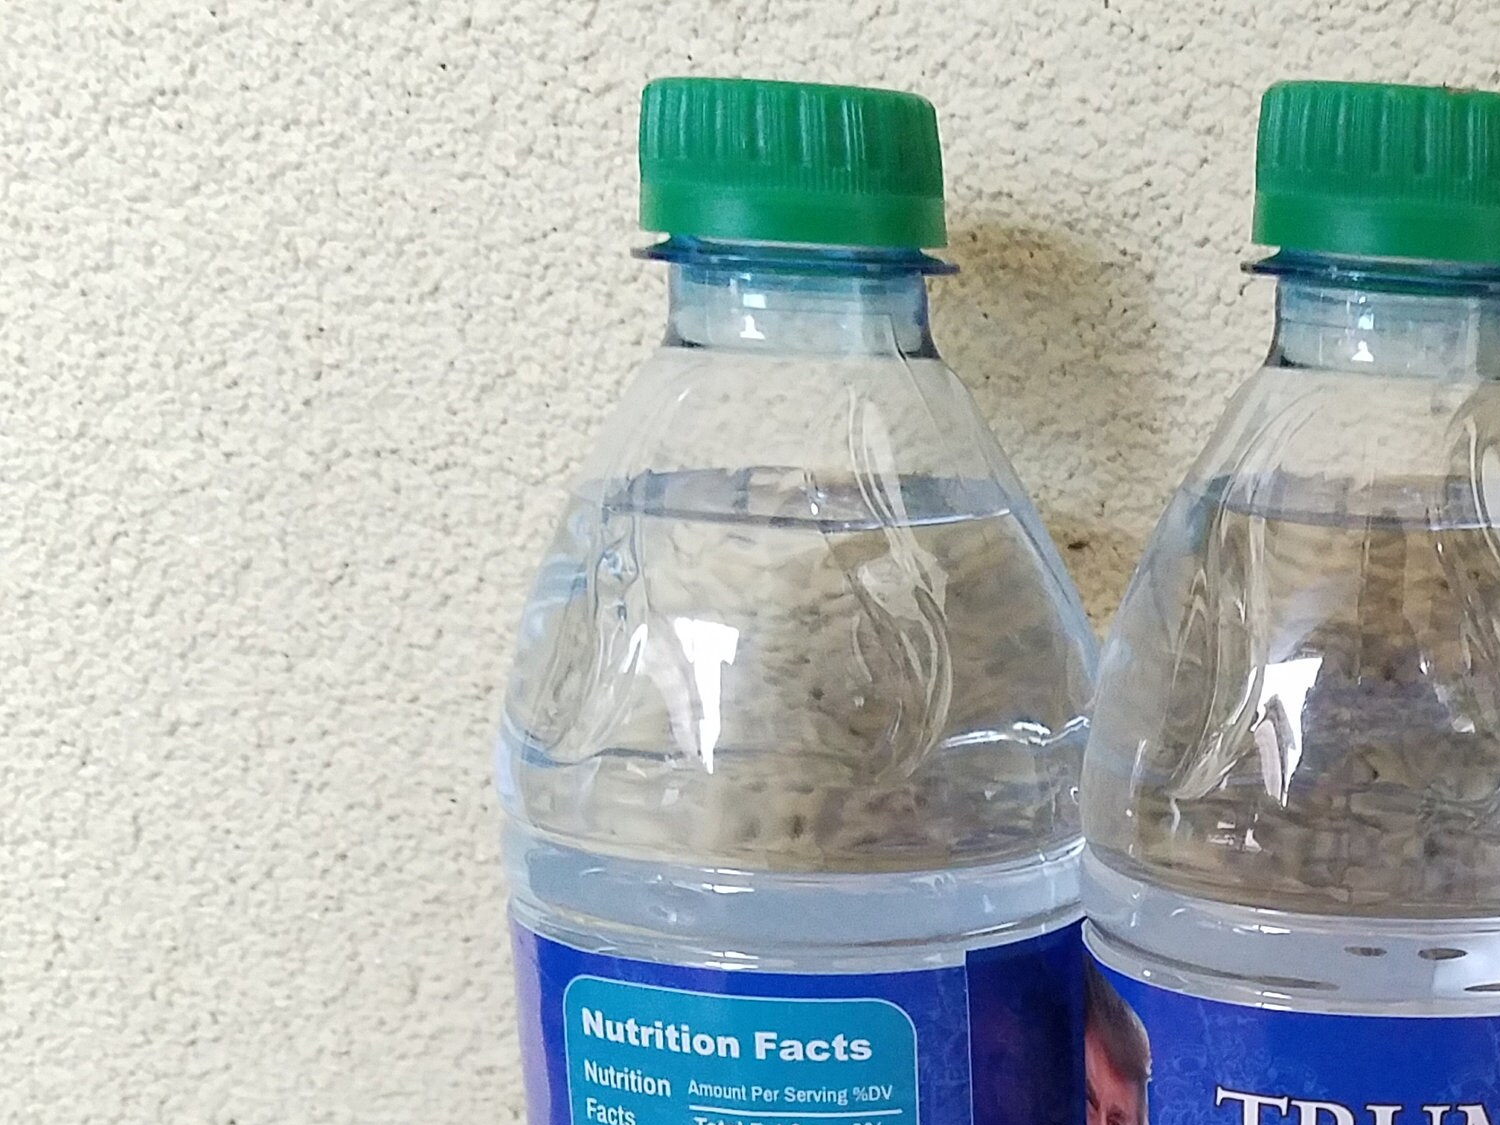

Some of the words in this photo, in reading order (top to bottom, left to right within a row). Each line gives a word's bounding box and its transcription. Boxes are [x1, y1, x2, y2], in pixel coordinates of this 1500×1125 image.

[581, 1007, 740, 1058] Nutrition
[755, 1032, 872, 1061] Facts
[583, 1059, 671, 1097] Nutrition
[688, 1081, 746, 1101] Amount
[752, 1087, 779, 1102] Per
[784, 1086, 848, 1106] Serving
[853, 1085, 892, 1102] %DV
